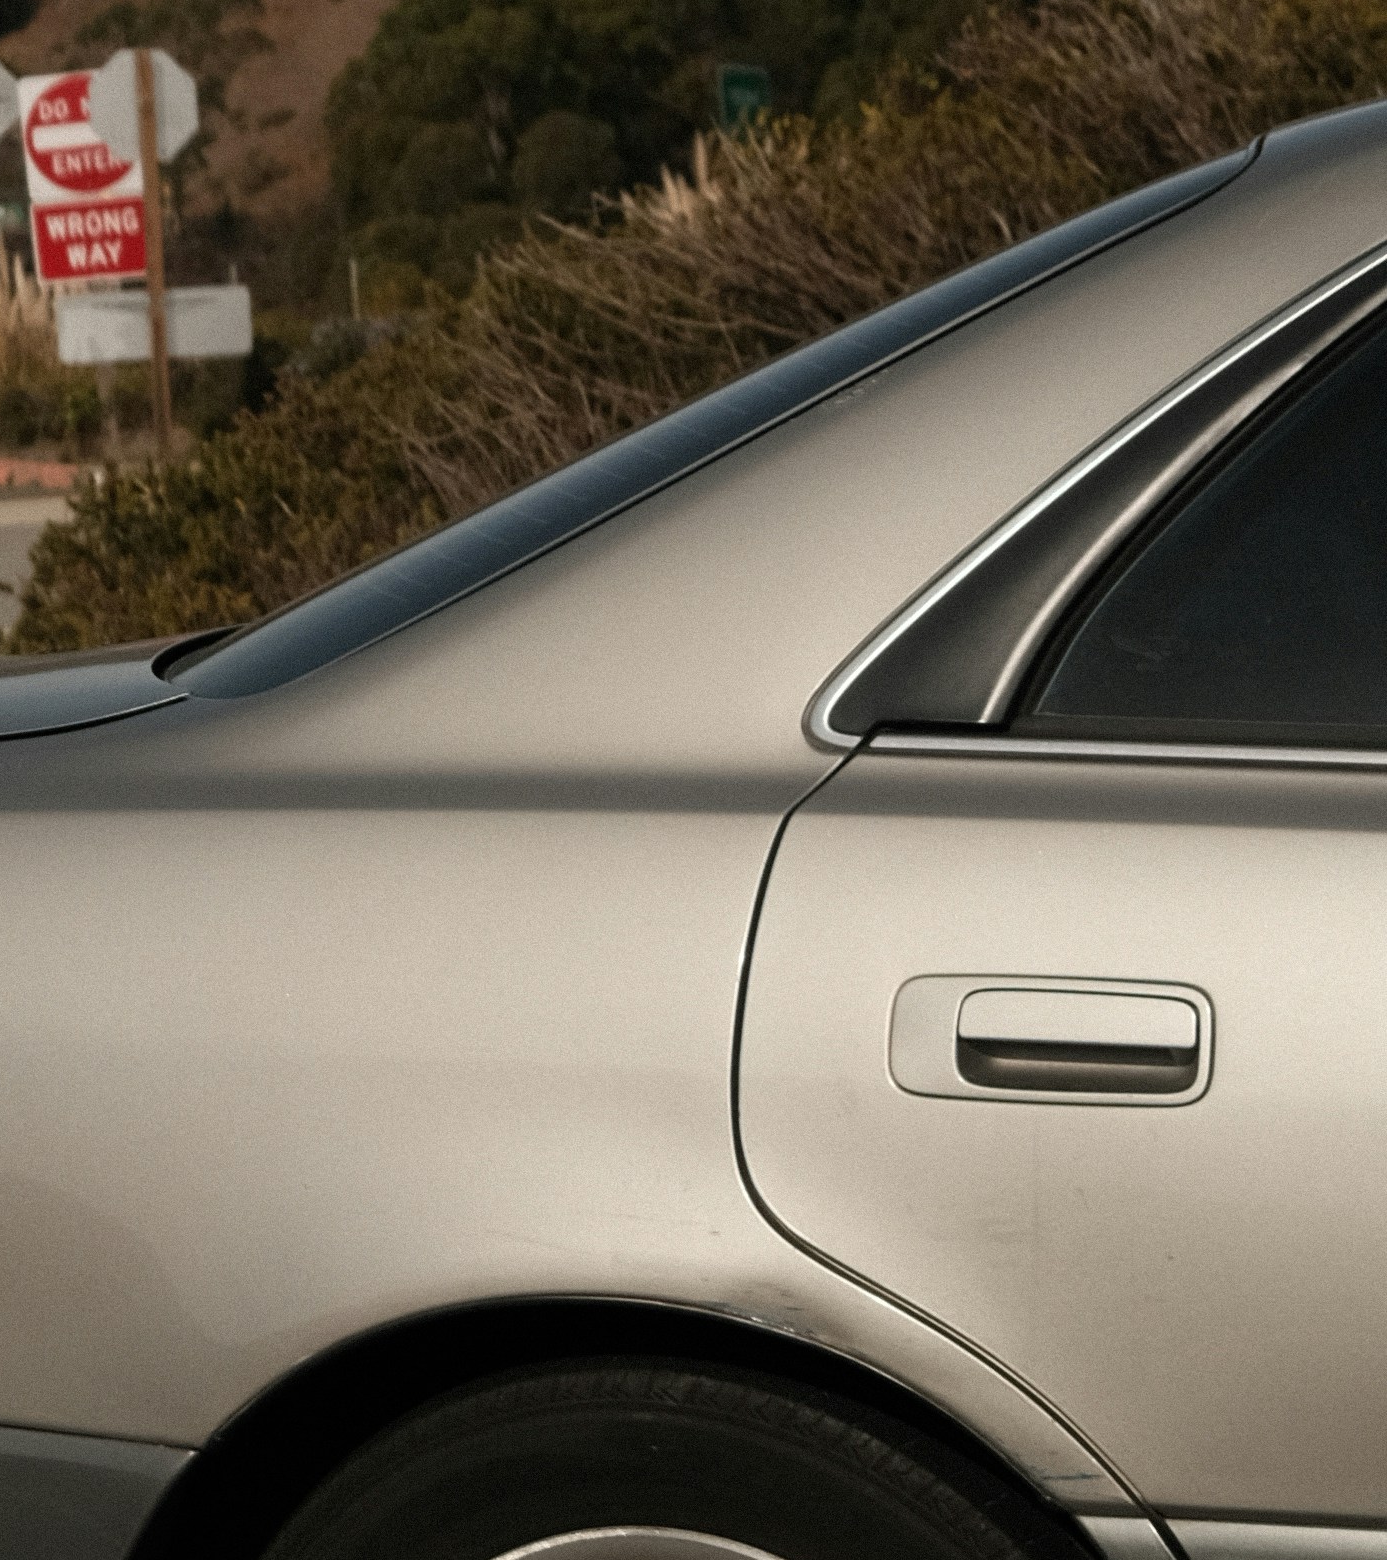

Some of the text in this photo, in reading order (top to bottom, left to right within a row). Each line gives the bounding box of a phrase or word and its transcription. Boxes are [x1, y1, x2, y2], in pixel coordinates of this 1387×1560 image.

[40, 98, 69, 121] DO
[47, 207, 139, 241] WRONG
[68, 241, 122, 269] WAY
